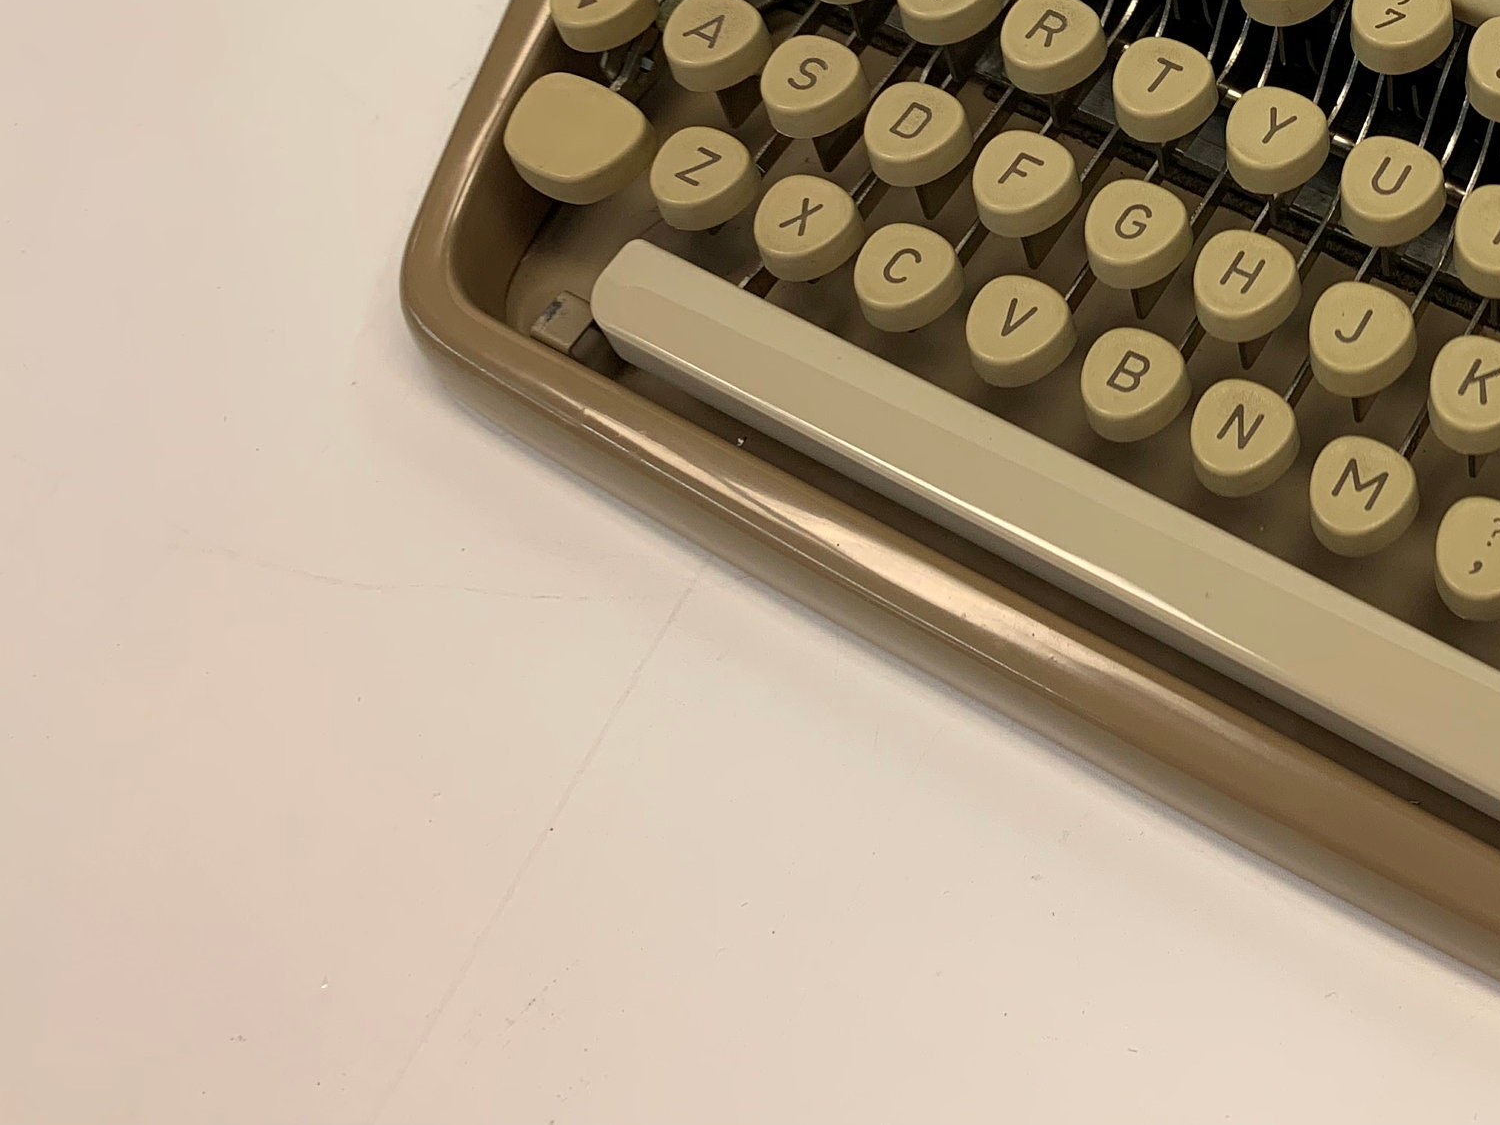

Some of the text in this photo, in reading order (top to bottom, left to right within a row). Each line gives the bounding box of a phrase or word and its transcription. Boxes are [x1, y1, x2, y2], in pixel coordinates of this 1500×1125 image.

[682, 14, 726, 49] A
[1024, 8, 1068, 48] R
[1374, 7, 1407, 29] 7
[787, 57, 829, 91] S
[1147, 57, 1184, 93] T
[888, 101, 933, 140] D
[1261, 106, 1298, 145] Y
[674, 146, 723, 187] Z
[997, 152, 1045, 185] F
[1371, 156, 1413, 196] U
[778, 197, 824, 237] X
[1114, 203, 1153, 240] G
[882, 247, 922, 284] C
[1219, 250, 1266, 295] H
[1000, 297, 1039, 337] V
[1334, 309, 1374, 344] J
[1106, 349, 1151, 393] B
[1216, 403, 1265, 450] N
[1331, 457, 1390, 512] M
